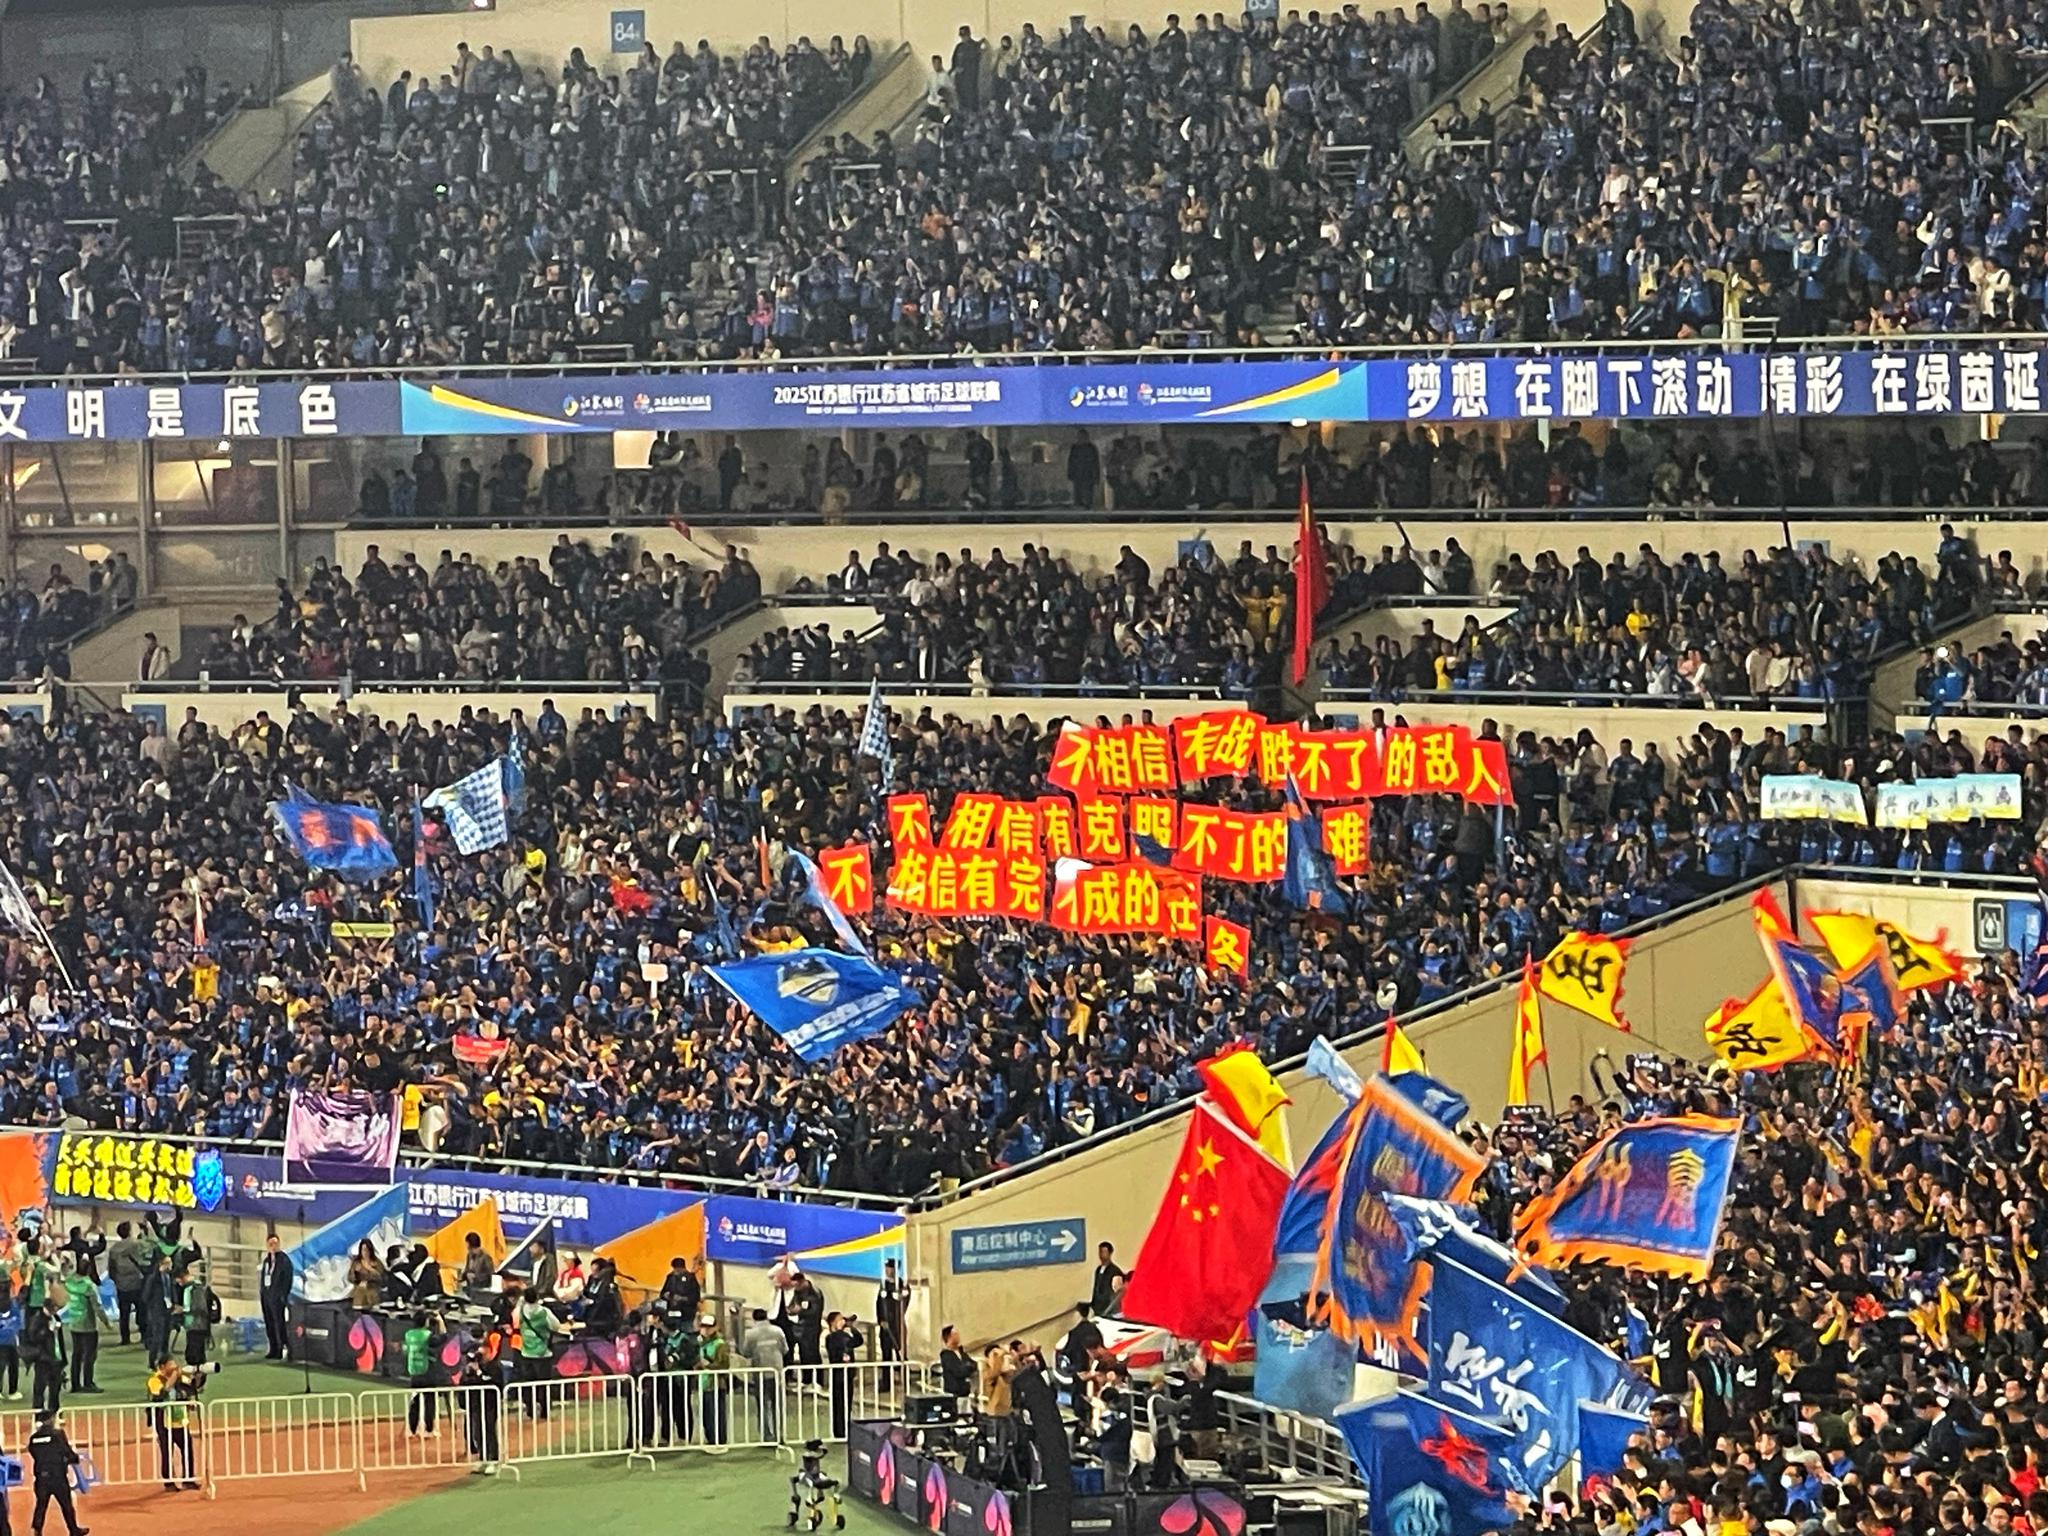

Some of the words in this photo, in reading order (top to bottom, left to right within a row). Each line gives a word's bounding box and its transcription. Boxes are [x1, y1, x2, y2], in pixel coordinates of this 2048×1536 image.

[0, 385, 337, 438] 文明是底色
[1407, 361, 1487, 418] 梦想
[1515, 359, 1732, 416] 在脚下滚动
[1872, 351, 2041, 414] 在绿茵诞
[893, 799, 1366, 877] 不相信有克服不了的难
